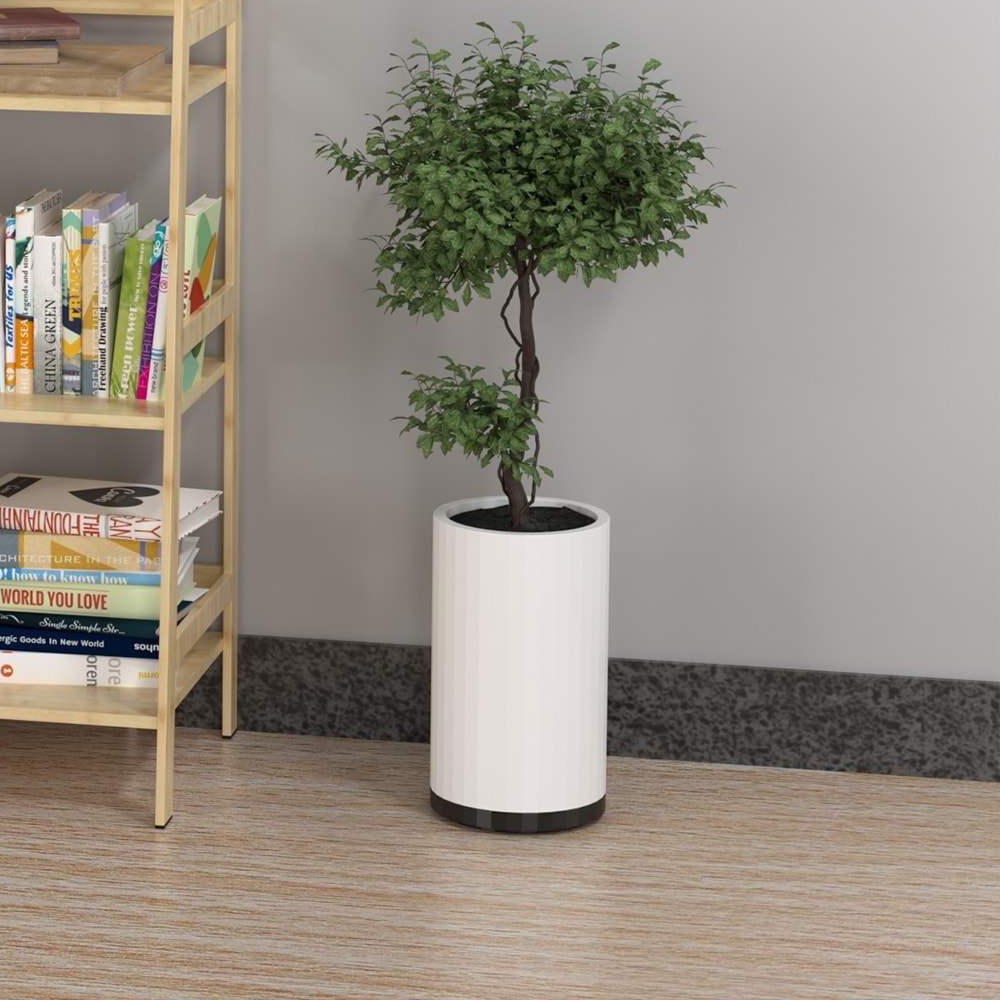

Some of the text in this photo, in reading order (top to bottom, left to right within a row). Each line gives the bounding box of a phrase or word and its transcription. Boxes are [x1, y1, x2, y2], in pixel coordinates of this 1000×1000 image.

[5, 284, 14, 301] for
[22, 285, 31, 315] Legends
[5, 305, 14, 348] Textiles
[19, 319, 28, 338] SEA
[44, 299, 56, 343] GREEN
[98, 307, 109, 346] Drawing
[123, 306, 138, 351] power
[139, 272, 160, 389] EXHIBITION ON
[19, 339, 29, 374] BALTIC
[98, 348, 108, 391] Freehand
[44, 348, 56, 393] CHINA
[151, 362, 159, 381] brand
[83, 514, 100, 538] THE
[86, 555, 100, 564] IN
[104, 556, 132, 565] THE
[12, 568, 38, 582] how
[42, 570, 57, 583] to
[60, 569, 97, 584] know
[101, 572, 128, 585] how
[0, 588, 108, 610] WORLD YOU LOVE
[38, 617, 67, 630] Single
[69, 619, 102, 634] Simple
[19, 636, 47, 645] Goods
[49, 637, 58, 645] In
[60, 638, 79, 646] New
[80, 639, 105, 648] World
[108, 657, 122, 685] ore
[138, 671, 159, 680] ormi
